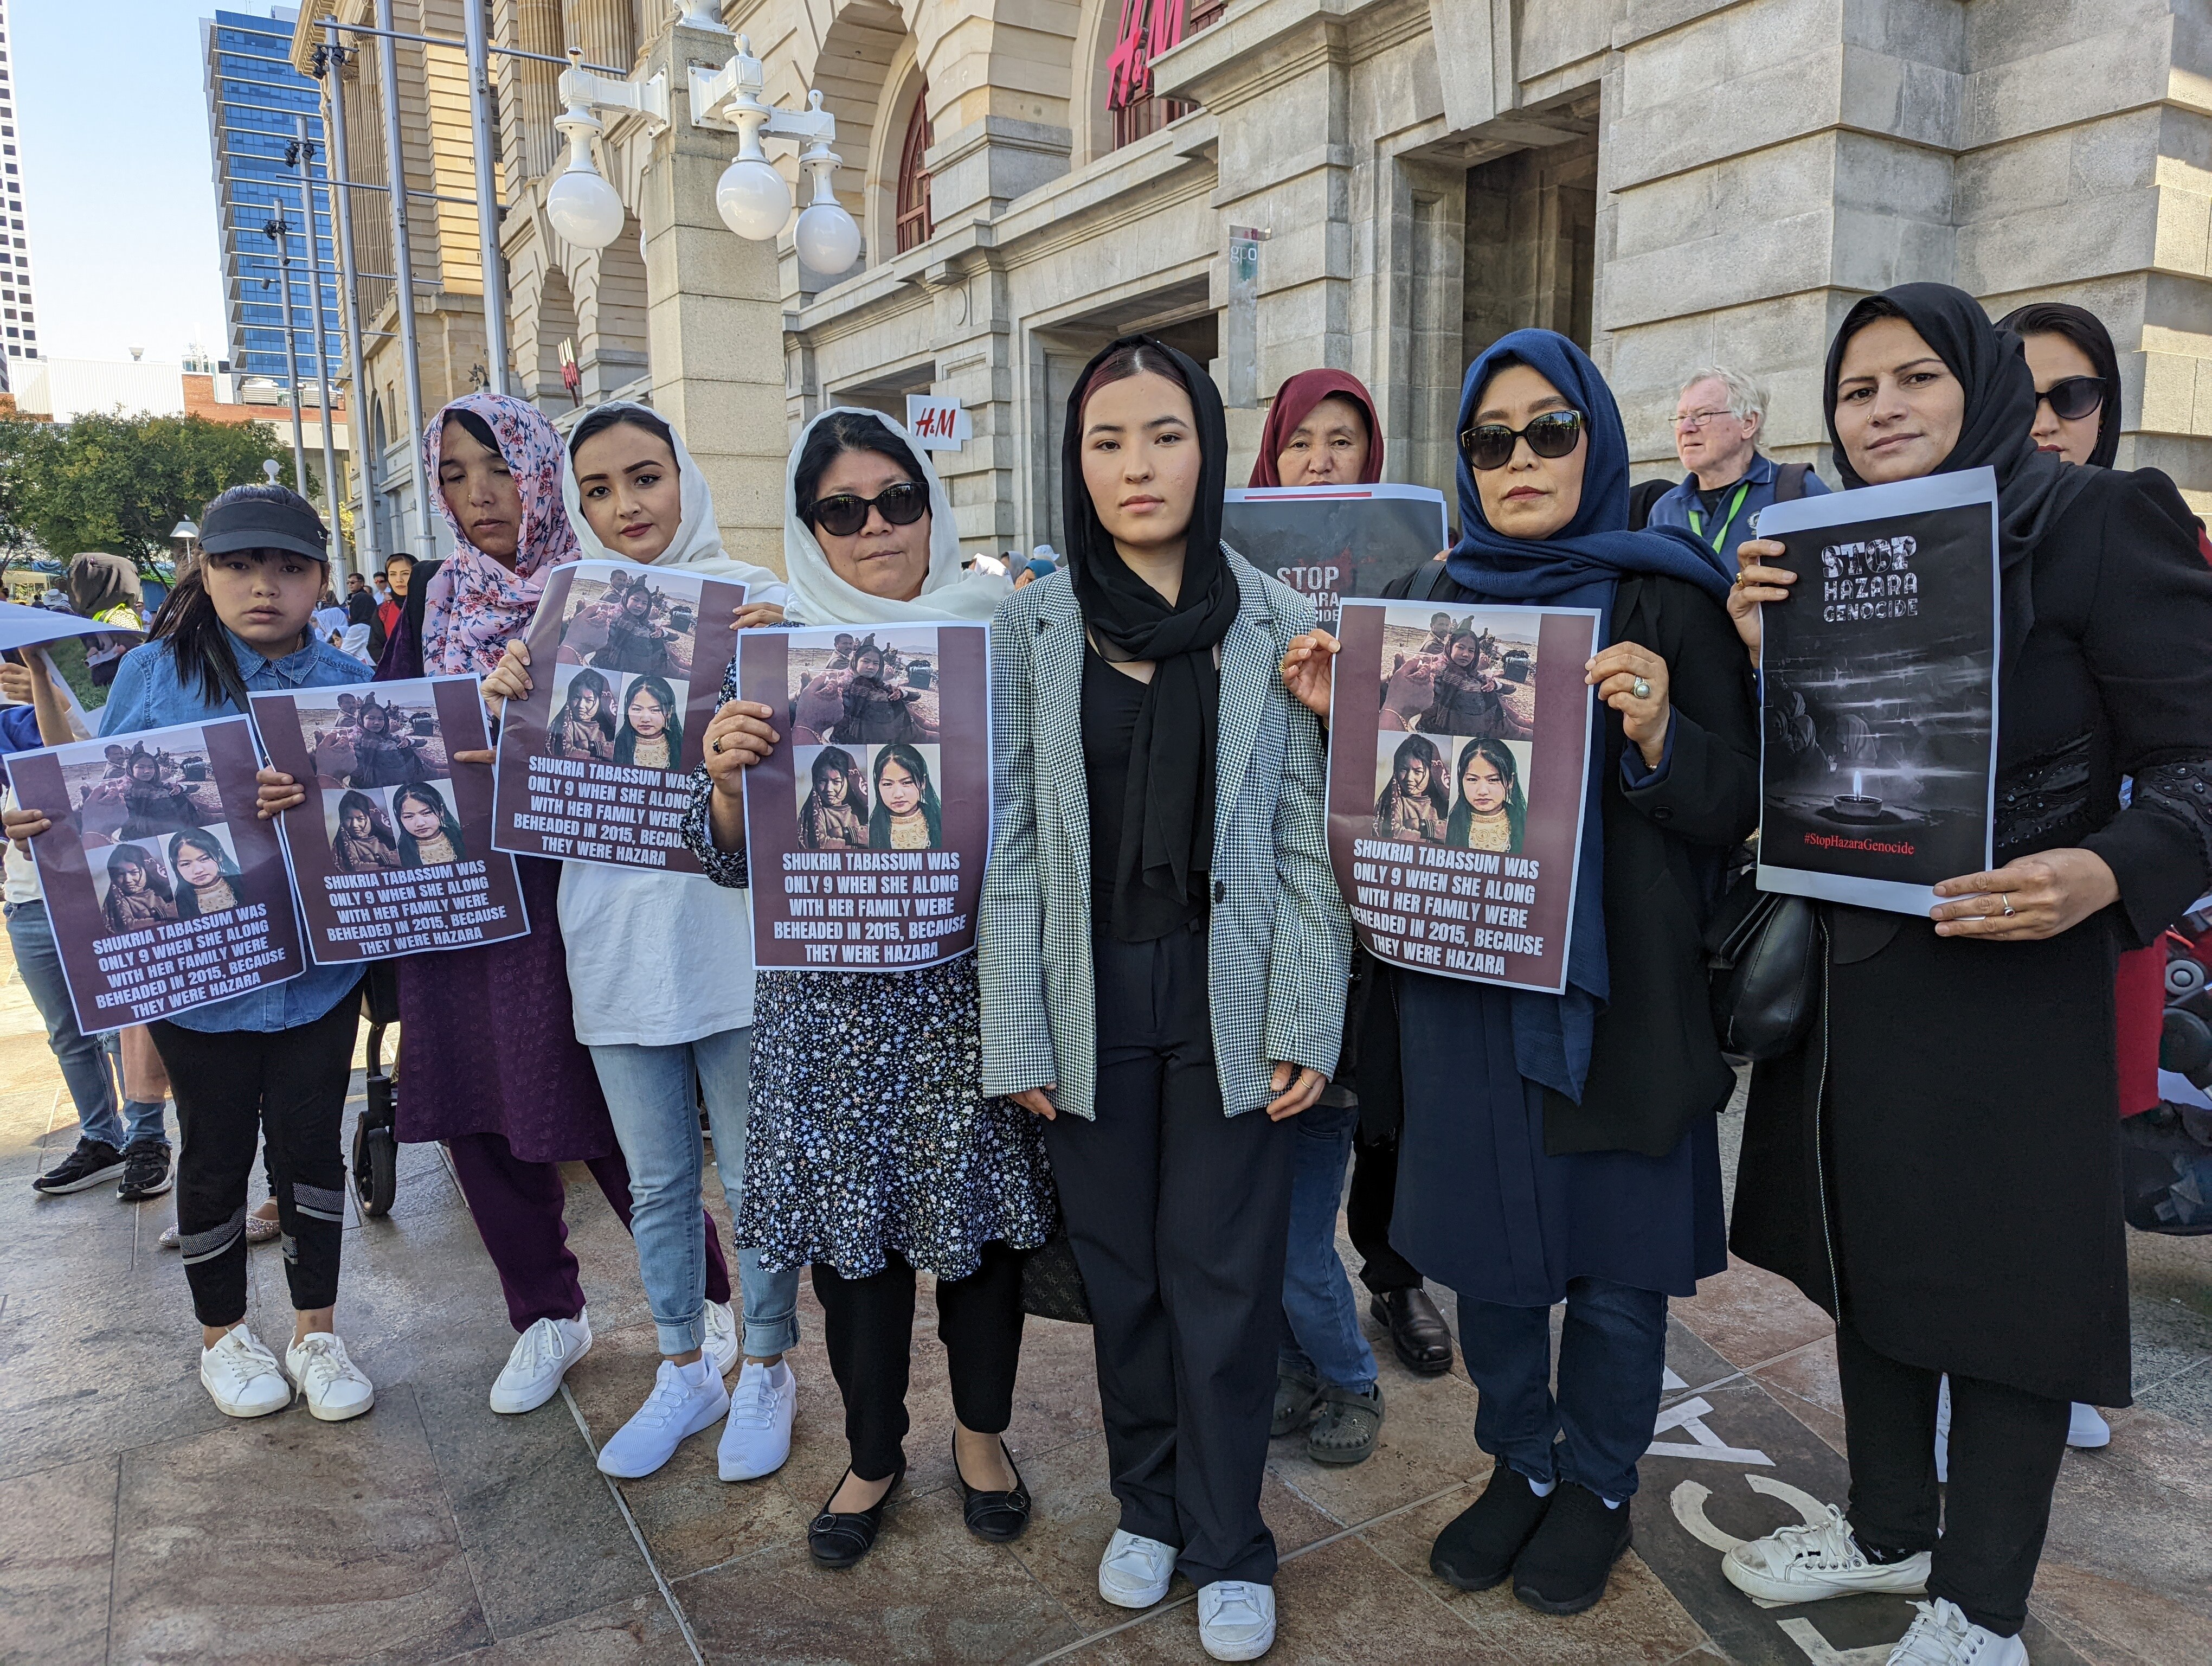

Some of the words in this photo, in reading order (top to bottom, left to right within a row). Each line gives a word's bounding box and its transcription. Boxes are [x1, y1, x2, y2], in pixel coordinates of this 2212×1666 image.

[1230, 246, 1257, 264] gpo
[915, 408, 956, 439] H&M
[1822, 536, 1917, 578] STOP
[1277, 566, 1339, 590] STOP
[1824, 572, 1918, 601] HAZARA
[1823, 598, 1918, 622] GENOCIDE
[529, 756, 584, 778] SHUKRIA
[589, 763, 660, 787] TABASSUM
[528, 775, 562, 794] ONLY
[564, 780, 574, 796] 9
[578, 782, 615, 802] WHEN
[620, 789, 645, 805] SHE
[648, 790, 691, 810] ALONG
[531, 795, 563, 815] WITH
[568, 801, 593, 819] HER
[596, 804, 645, 824] FAMILY
[514, 813, 580, 836] BEHEADED
[583, 823, 596, 838] IN
[600, 824, 636, 845] 2015,
[640, 828, 687, 849] BECAU
[1804, 832, 1915, 855] #StopHazaraGenocide
[542, 835, 573, 854] THEY
[577, 841, 612, 860] WERE
[616, 846, 666, 867] HAZARA
[782, 853, 841, 871] SHUKRIA
[846, 853, 922, 871] TABASSUM
[927, 853, 960, 870] WAS
[1354, 838, 1413, 864] SHUKRIA
[1419, 847, 1500, 875] TABASSUM
[1504, 858, 1539, 880] WAS
[324, 873, 380, 889] SHUKRIA
[381, 864, 454, 885] TABASSUM
[455, 860, 486, 876] WAS
[785, 876, 820, 894] ONLY
[824, 876, 833, 894] 9
[837, 876, 877, 894] WHEN
[881, 876, 908, 894] SHE
[912, 875, 959, 893] ALONG
[1354, 862, 1388, 884] ONLY
[1391, 867, 1401, 886] 9
[1406, 869, 1448, 893] WHEN
[1452, 875, 1481, 897] SHE
[1484, 880, 1535, 905] ALONG
[329, 892, 361, 907] ONLY
[364, 891, 375, 904] 9
[376, 887, 416, 903] WHEN
[420, 882, 445, 898] SHE
[447, 876, 489, 895] ALONG
[789, 899, 824, 917] WITH
[828, 899, 854, 917] HER
[859, 899, 911, 917] FAMILY
[915, 897, 954, 916] WERE
[326, 924, 392, 941] BEHEADED
[395, 920, 409, 934] IN
[412, 917, 448, 932] 2015,
[450, 905, 507, 927] BECAUSE
[336, 908, 370, 924] WITH
[373, 905, 399, 920] HER
[401, 899, 449, 917] FAMILY
[452, 893, 489, 910] WERE
[1357, 886, 1390, 908] WITH
[1393, 891, 1420, 913] HER
[1424, 896, 1481, 922] FAMILY
[1485, 905, 1528, 929] WERE
[93, 930, 155, 954] SHUKRIA
[157, 911, 233, 943] TABASSUM
[235, 904, 267, 921] WAS
[358, 939, 390, 955] THEY
[394, 934, 431, 950] WERE
[433, 926, 483, 945] HAZARA
[774, 922, 843, 939] BEHEADED
[847, 922, 861, 940] IN
[865, 922, 904, 942] 2015,
[909, 914, 967, 939] BECAUSE
[1349, 904, 1406, 934] BEHEADED
[1410, 918, 1425, 938] IN
[1428, 922, 1469, 947] 2015,
[1474, 928, 1544, 956] BECAUSE
[99, 952, 134, 972] ONLY
[139, 949, 150, 963] 9
[152, 938, 193, 960] WHEN
[196, 931, 223, 949] SHE
[227, 919, 269, 941] ALONG
[805, 945, 838, 963] THEY
[841, 945, 879, 963] WERE
[884, 941, 938, 963] HAZARA
[1371, 933, 1400, 957] THEY
[1403, 941, 1442, 965] WERE
[1445, 949, 1504, 976] HAZARA
[107, 969, 144, 988] WITH
[147, 961, 175, 978] HER
[178, 947, 228, 971] FAMILY
[230, 936, 269, 957] WERE
[95, 981, 167, 1009] BEHEADED
[170, 976, 185, 990] IN
[189, 965, 226, 985] 2015,
[229, 947, 286, 975] BECAUSE
[131, 998, 164, 1018] THEY
[168, 988, 207, 1009] WERE
[209, 971, 261, 996] HAZARA
